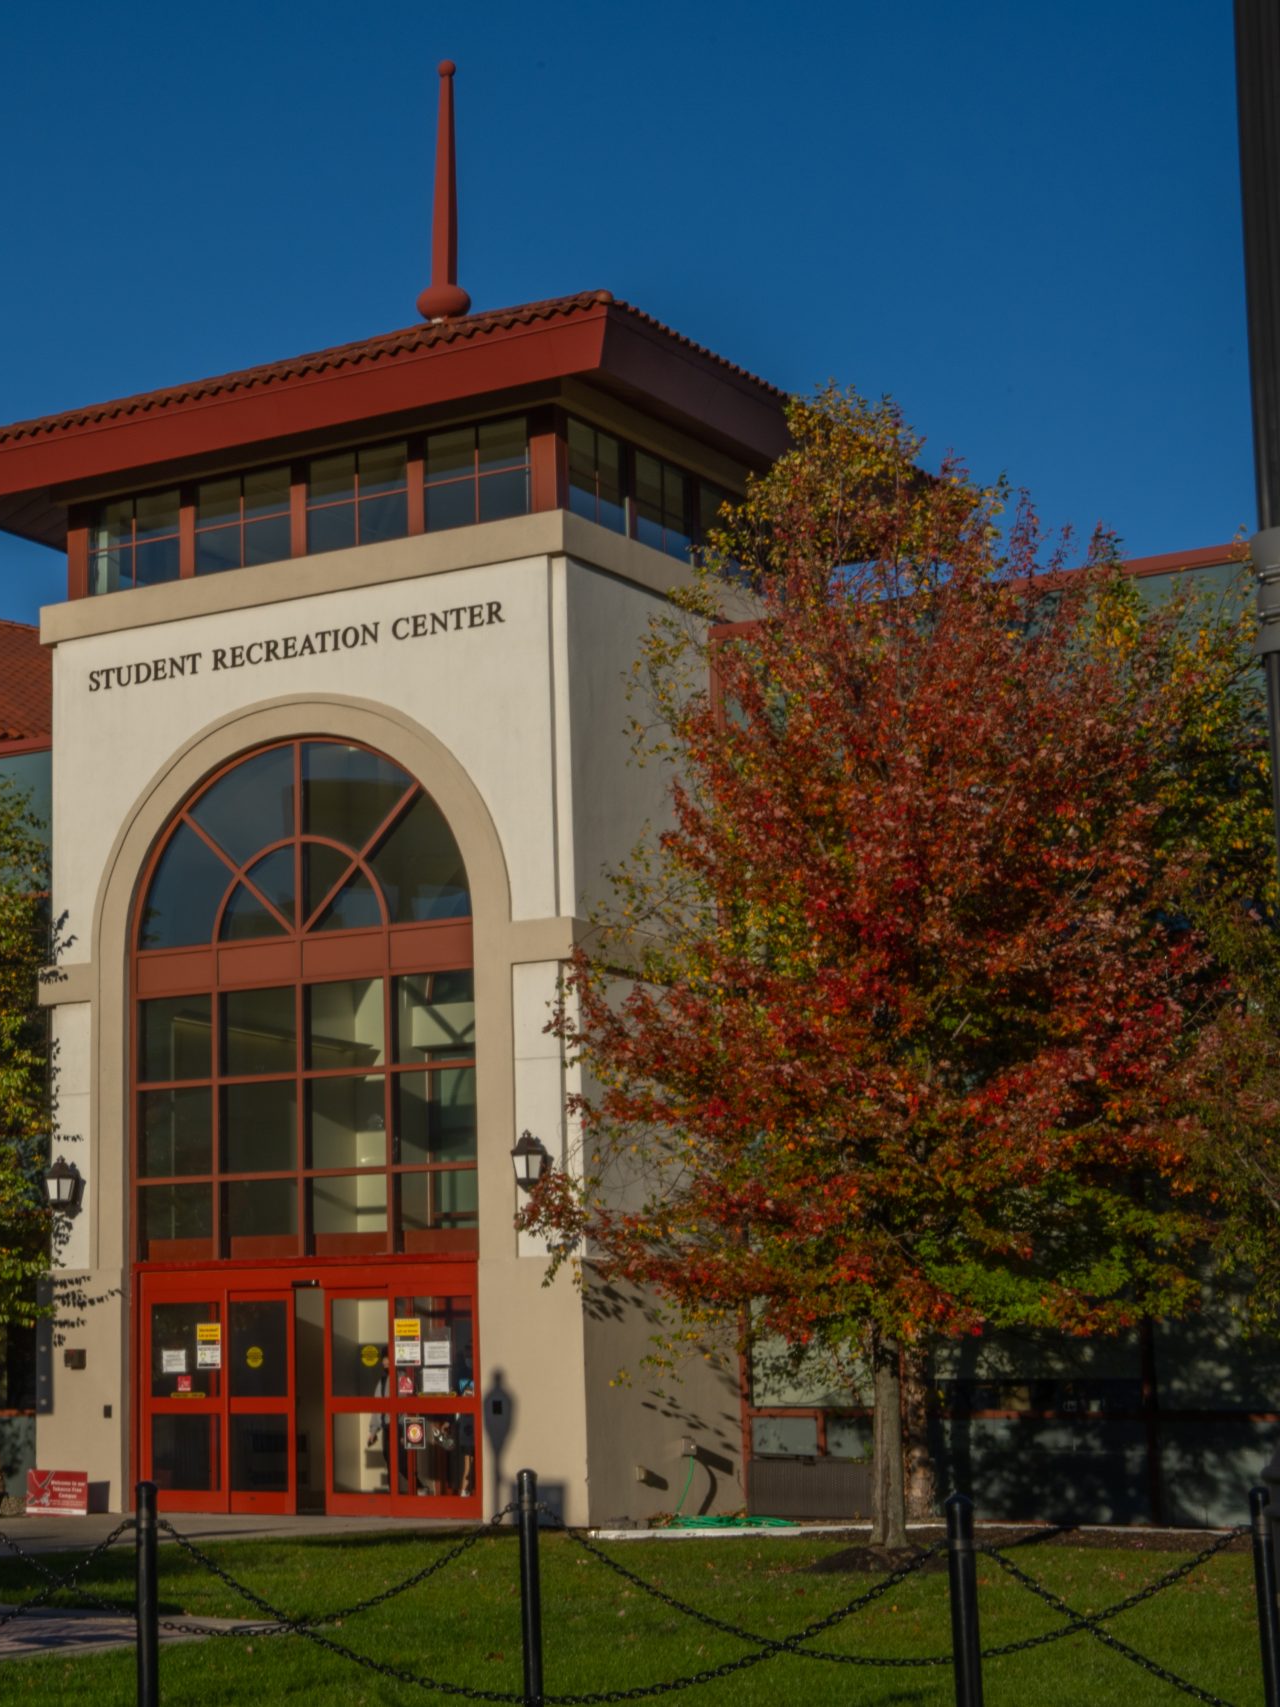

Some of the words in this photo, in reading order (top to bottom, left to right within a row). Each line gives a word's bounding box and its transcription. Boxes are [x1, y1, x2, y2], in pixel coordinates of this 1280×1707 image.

[89, 653, 202, 692] STUDENT
[211, 622, 380, 672] RECREATION
[391, 600, 505, 641] CENTER
